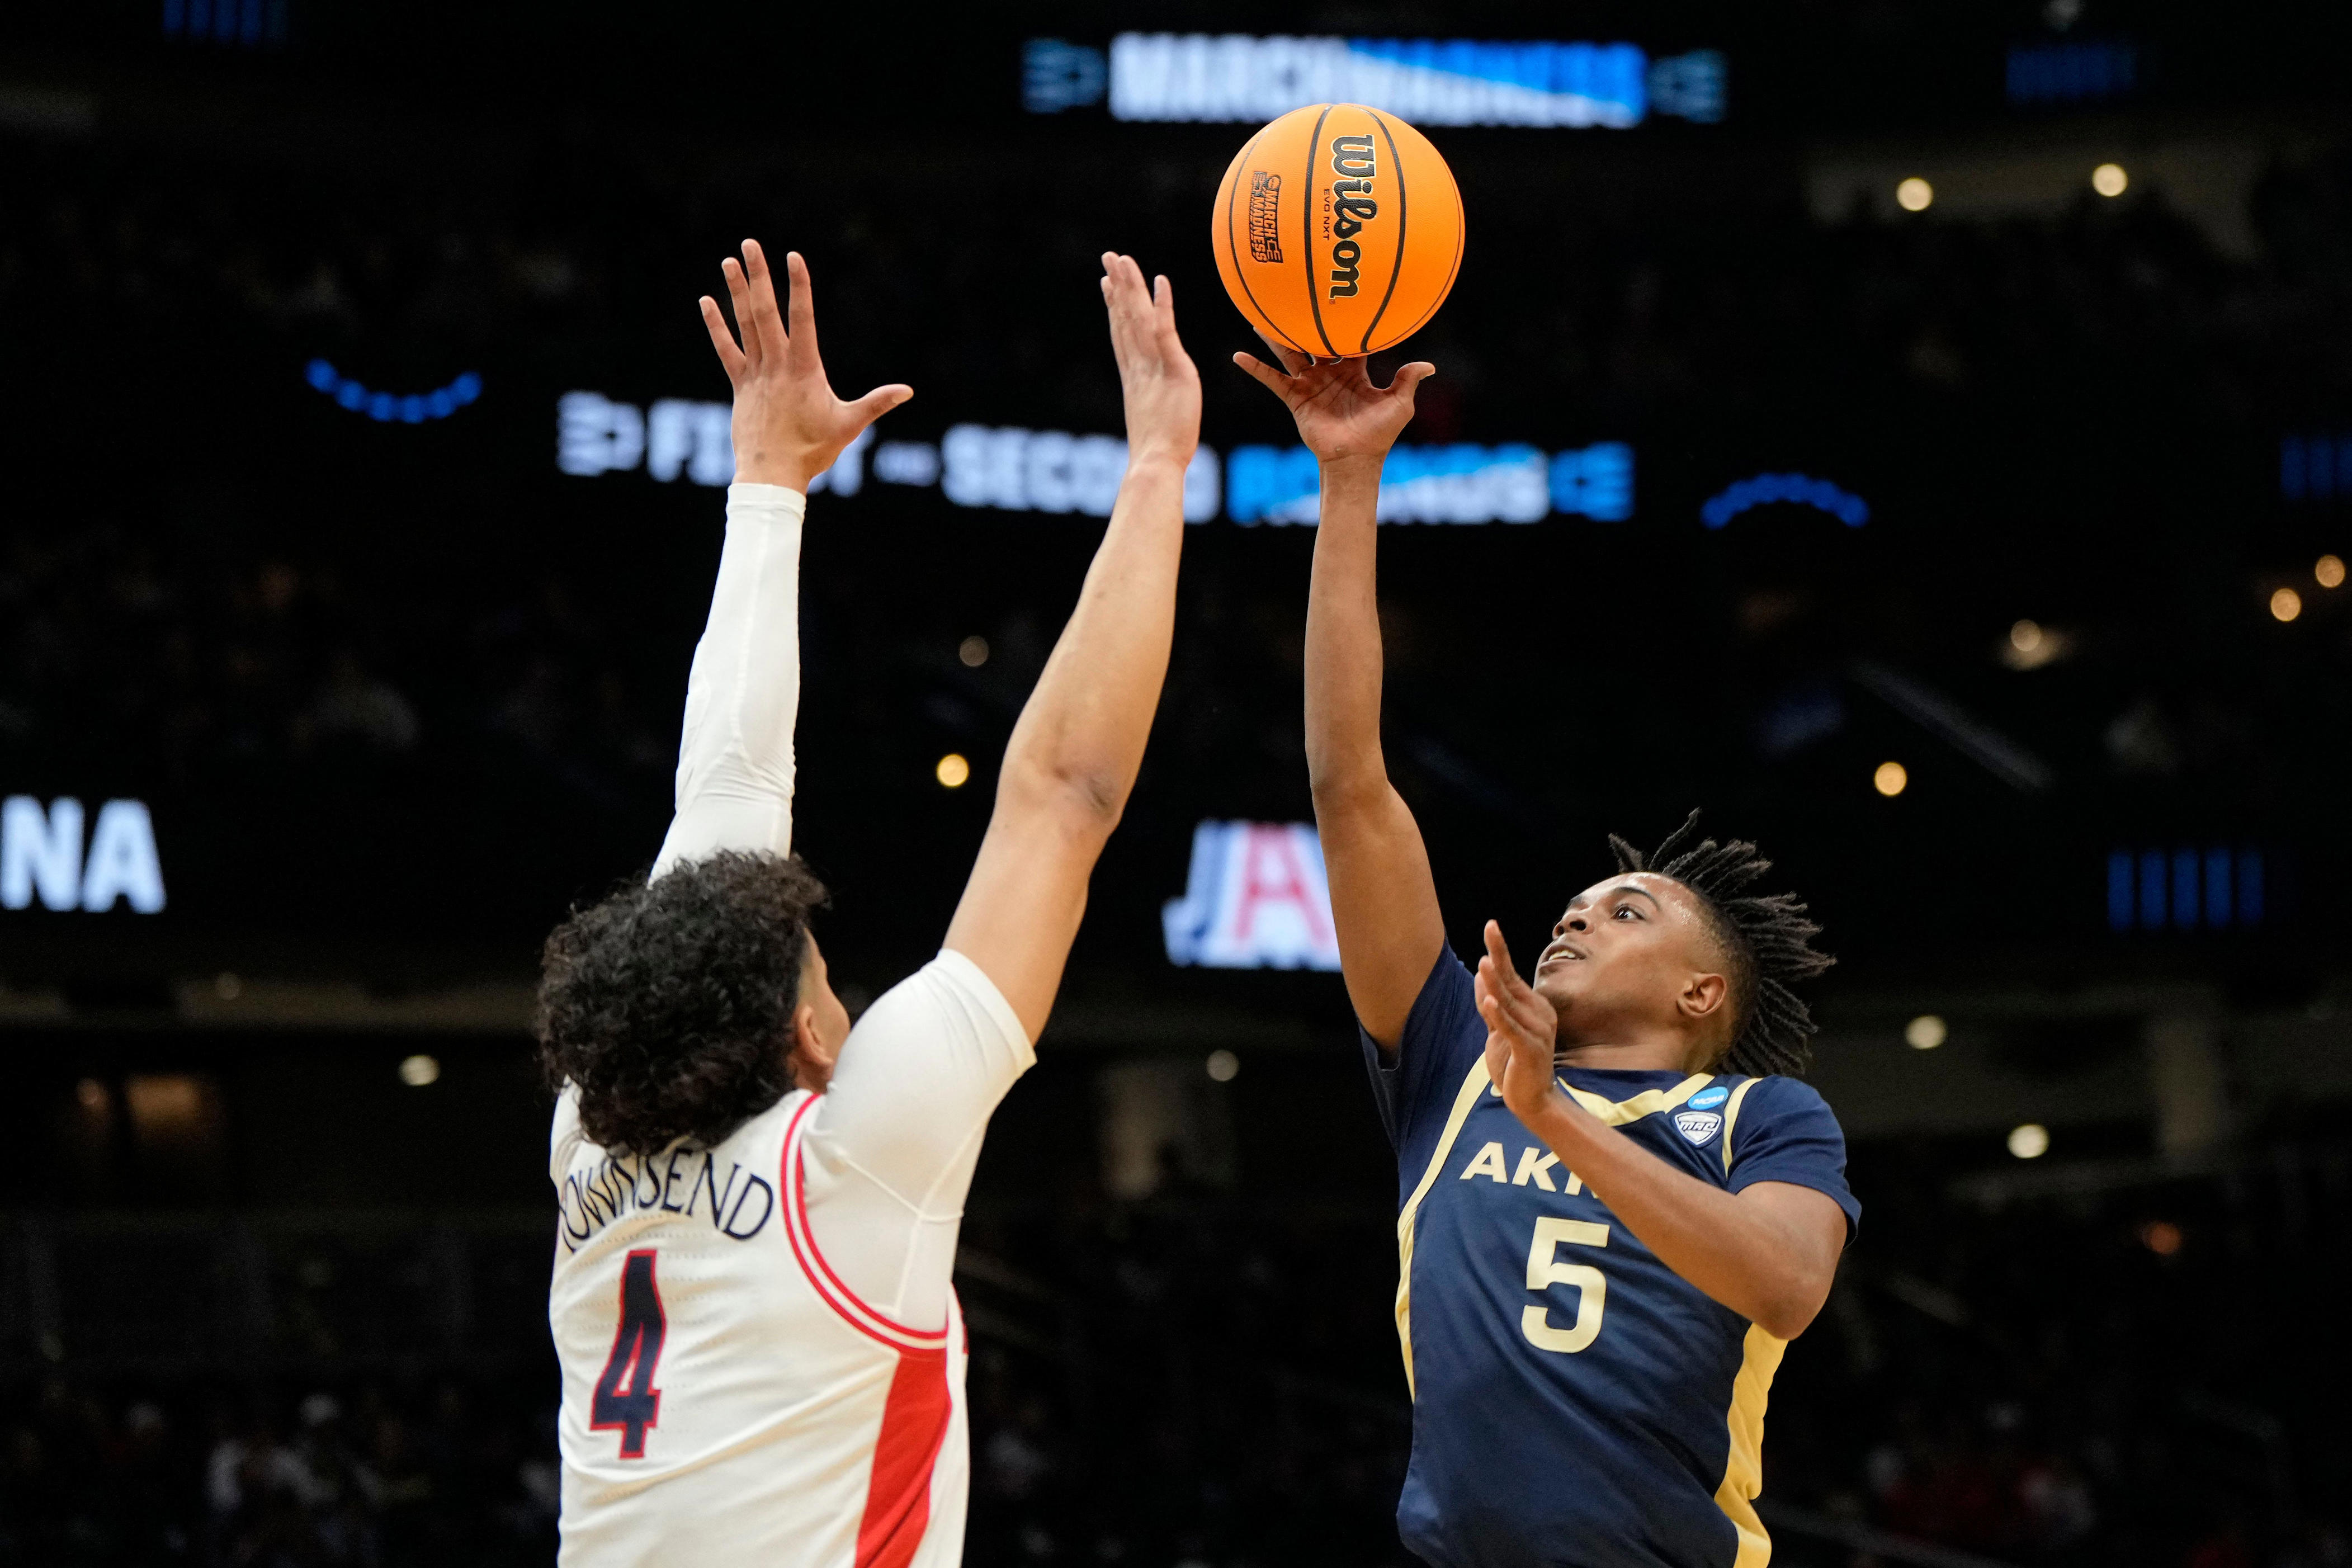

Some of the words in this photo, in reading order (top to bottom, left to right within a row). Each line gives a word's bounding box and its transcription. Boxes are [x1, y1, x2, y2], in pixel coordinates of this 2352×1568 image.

[1252, 195, 1268, 261] MADNESS
[1264, 186, 1278, 238] MARCH
[1329, 134, 1378, 300] Wilson
[0, 793, 167, 914] NA
[1521, 1216, 1610, 1354] 5
[590, 1249, 667, 1460] 4
